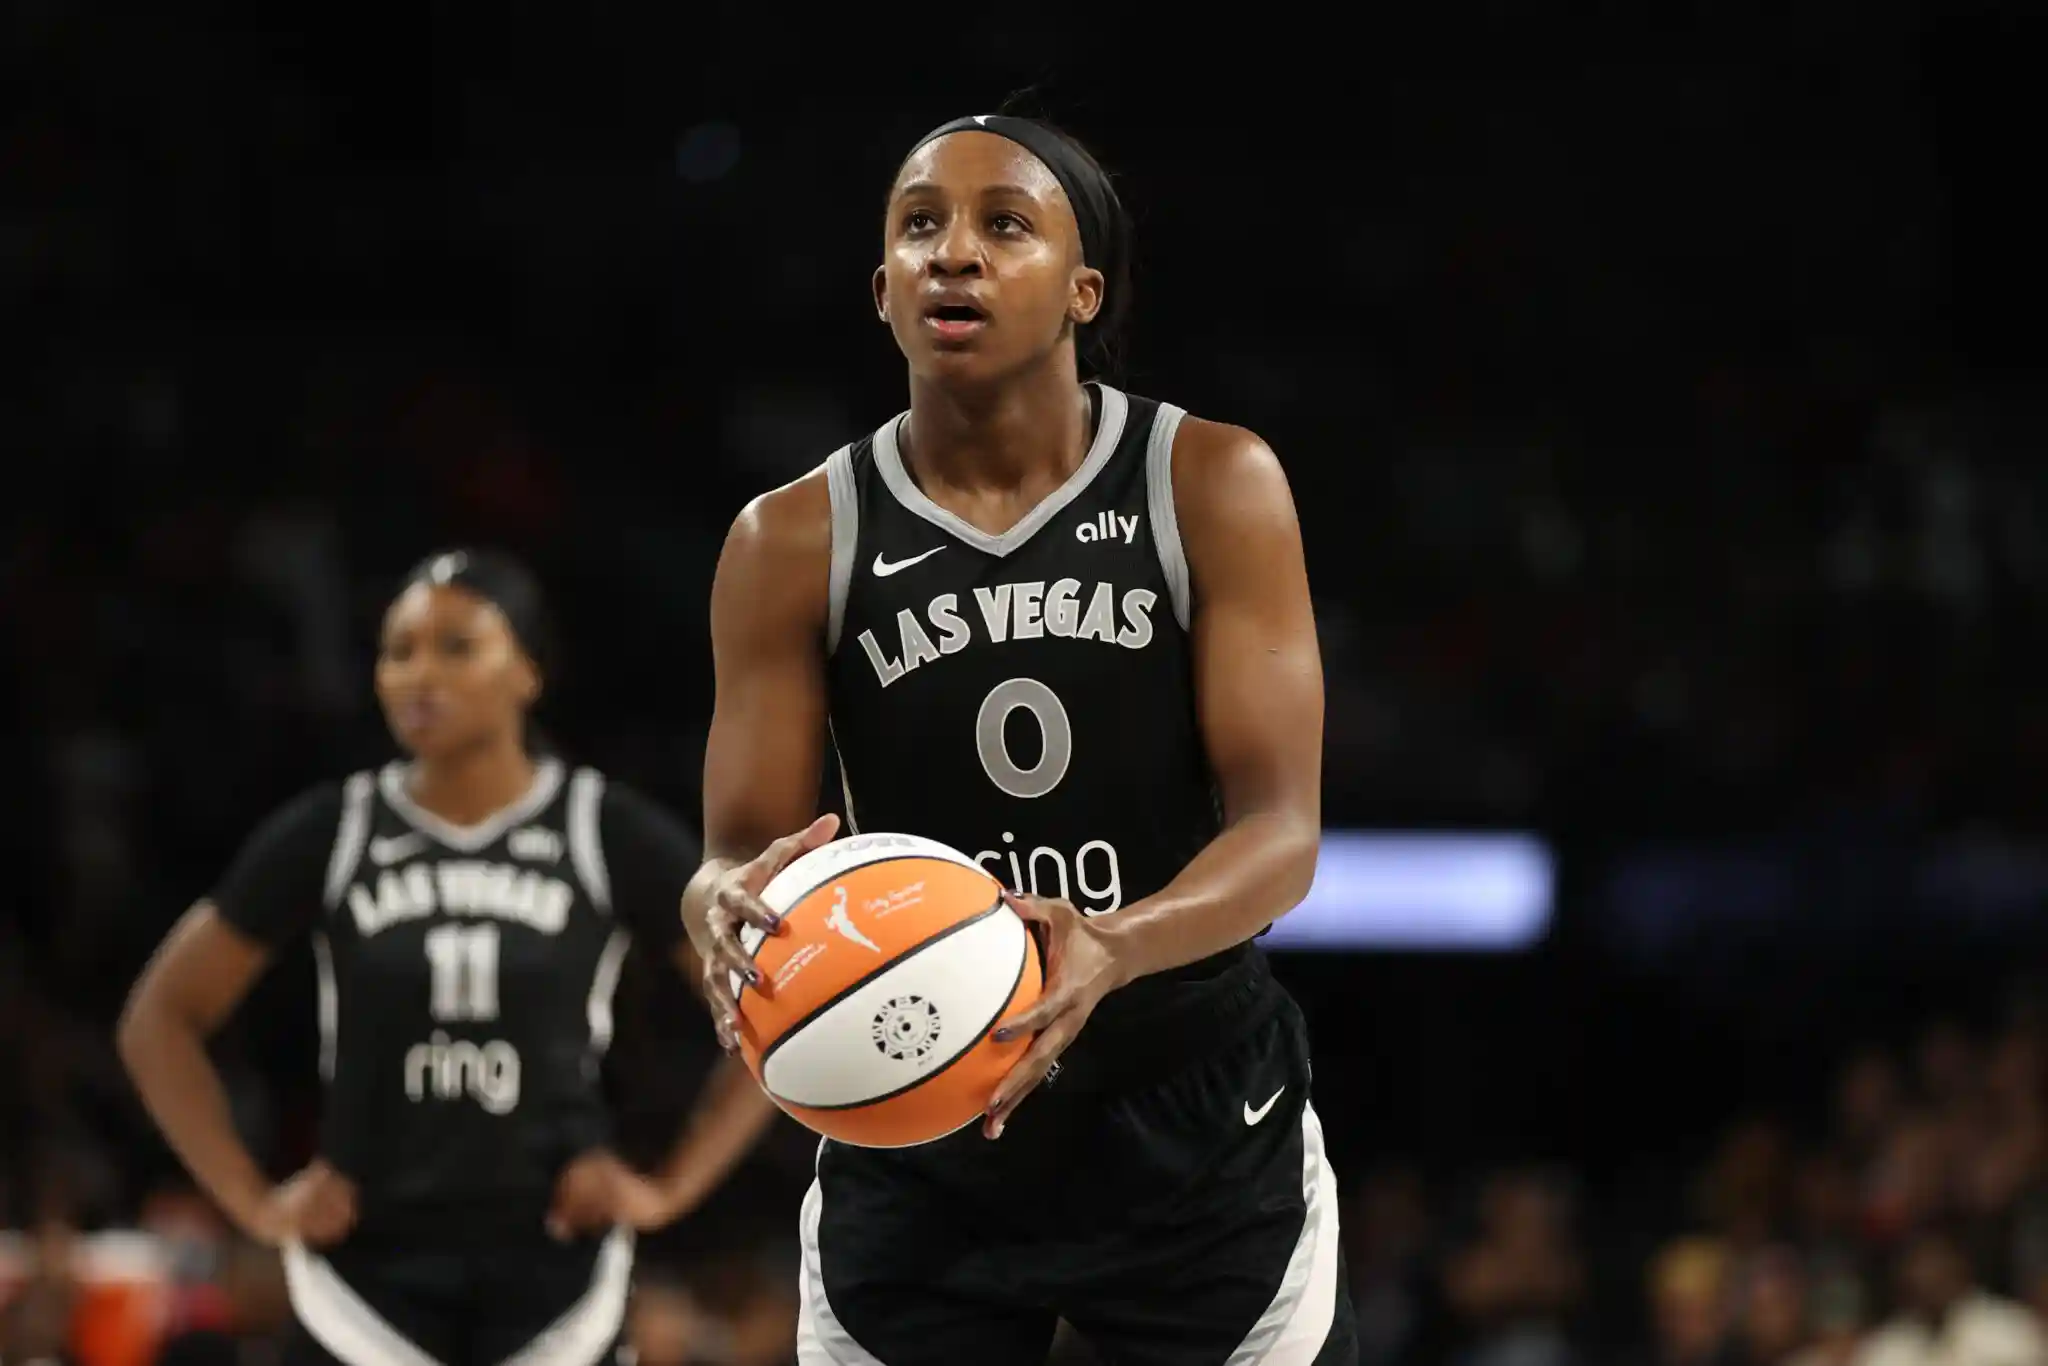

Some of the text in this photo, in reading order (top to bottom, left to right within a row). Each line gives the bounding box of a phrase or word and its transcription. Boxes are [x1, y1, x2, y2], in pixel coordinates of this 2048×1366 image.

[1076, 510, 1139, 544] ally
[858, 578, 1158, 688] LAS VEGAS
[976, 677, 1072, 799] 0
[425, 922, 500, 1021] 11
[405, 1029, 521, 1114] ring
